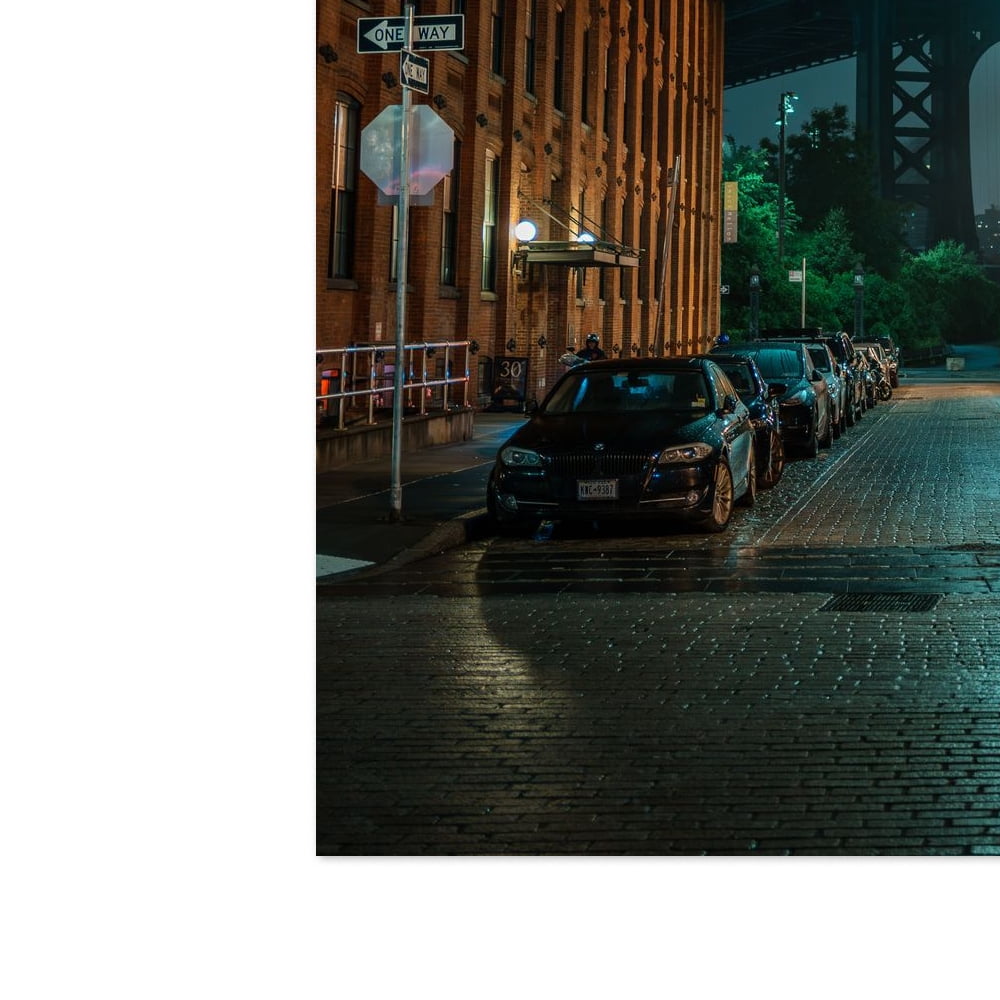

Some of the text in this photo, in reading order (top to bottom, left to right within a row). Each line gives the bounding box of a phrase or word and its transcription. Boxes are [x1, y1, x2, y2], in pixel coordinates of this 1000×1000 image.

[374, 25, 449, 42] ONE WAY
[500, 360, 522, 378] 30
